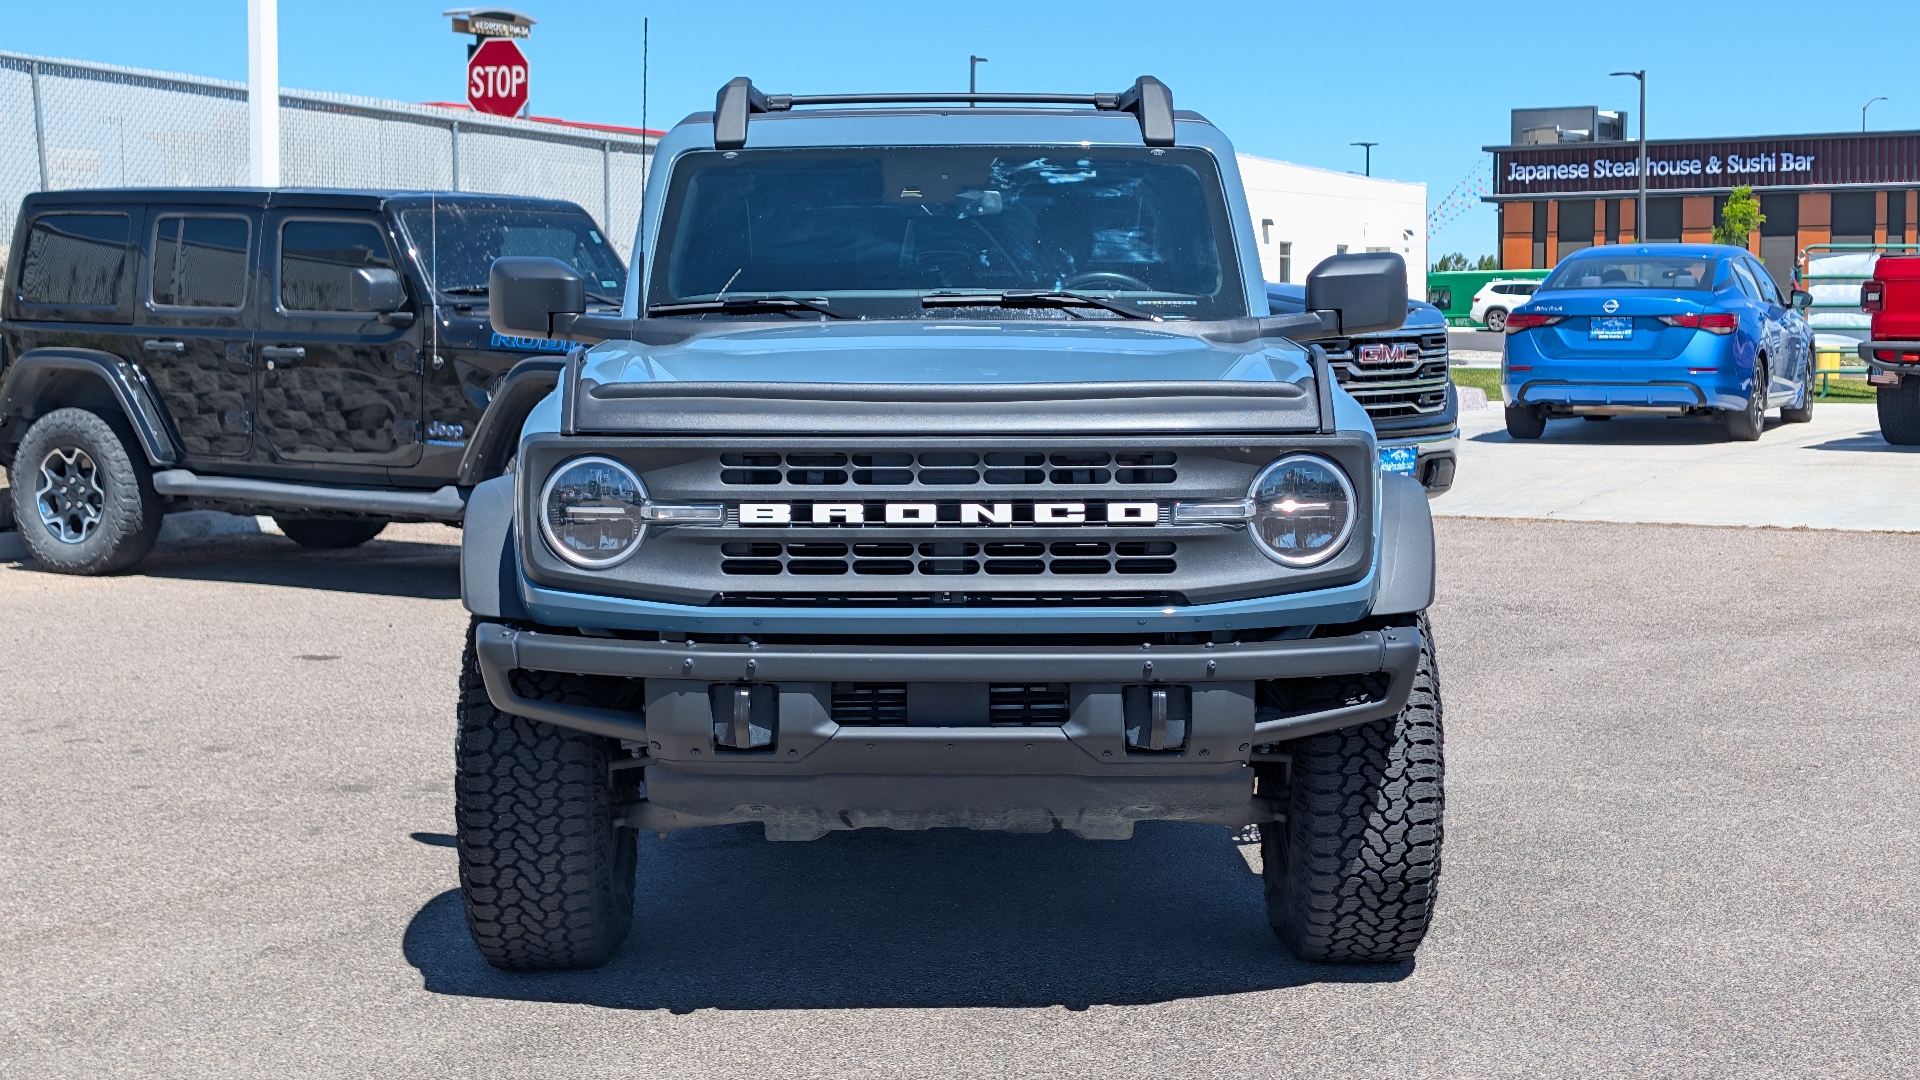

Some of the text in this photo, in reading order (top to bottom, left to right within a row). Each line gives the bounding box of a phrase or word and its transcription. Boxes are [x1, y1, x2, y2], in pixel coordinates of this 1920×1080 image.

[471, 65, 526, 98] STOP
[1507, 161, 1589, 184] Japanese
[1705, 155, 1722, 175] &
[1726, 152, 1776, 174] Sushi
[1780, 152, 1815, 172] Bar
[1361, 345, 1418, 363] GMC
[428, 420, 464, 440] Jeep
[739, 503, 1159, 526] BRONCO
